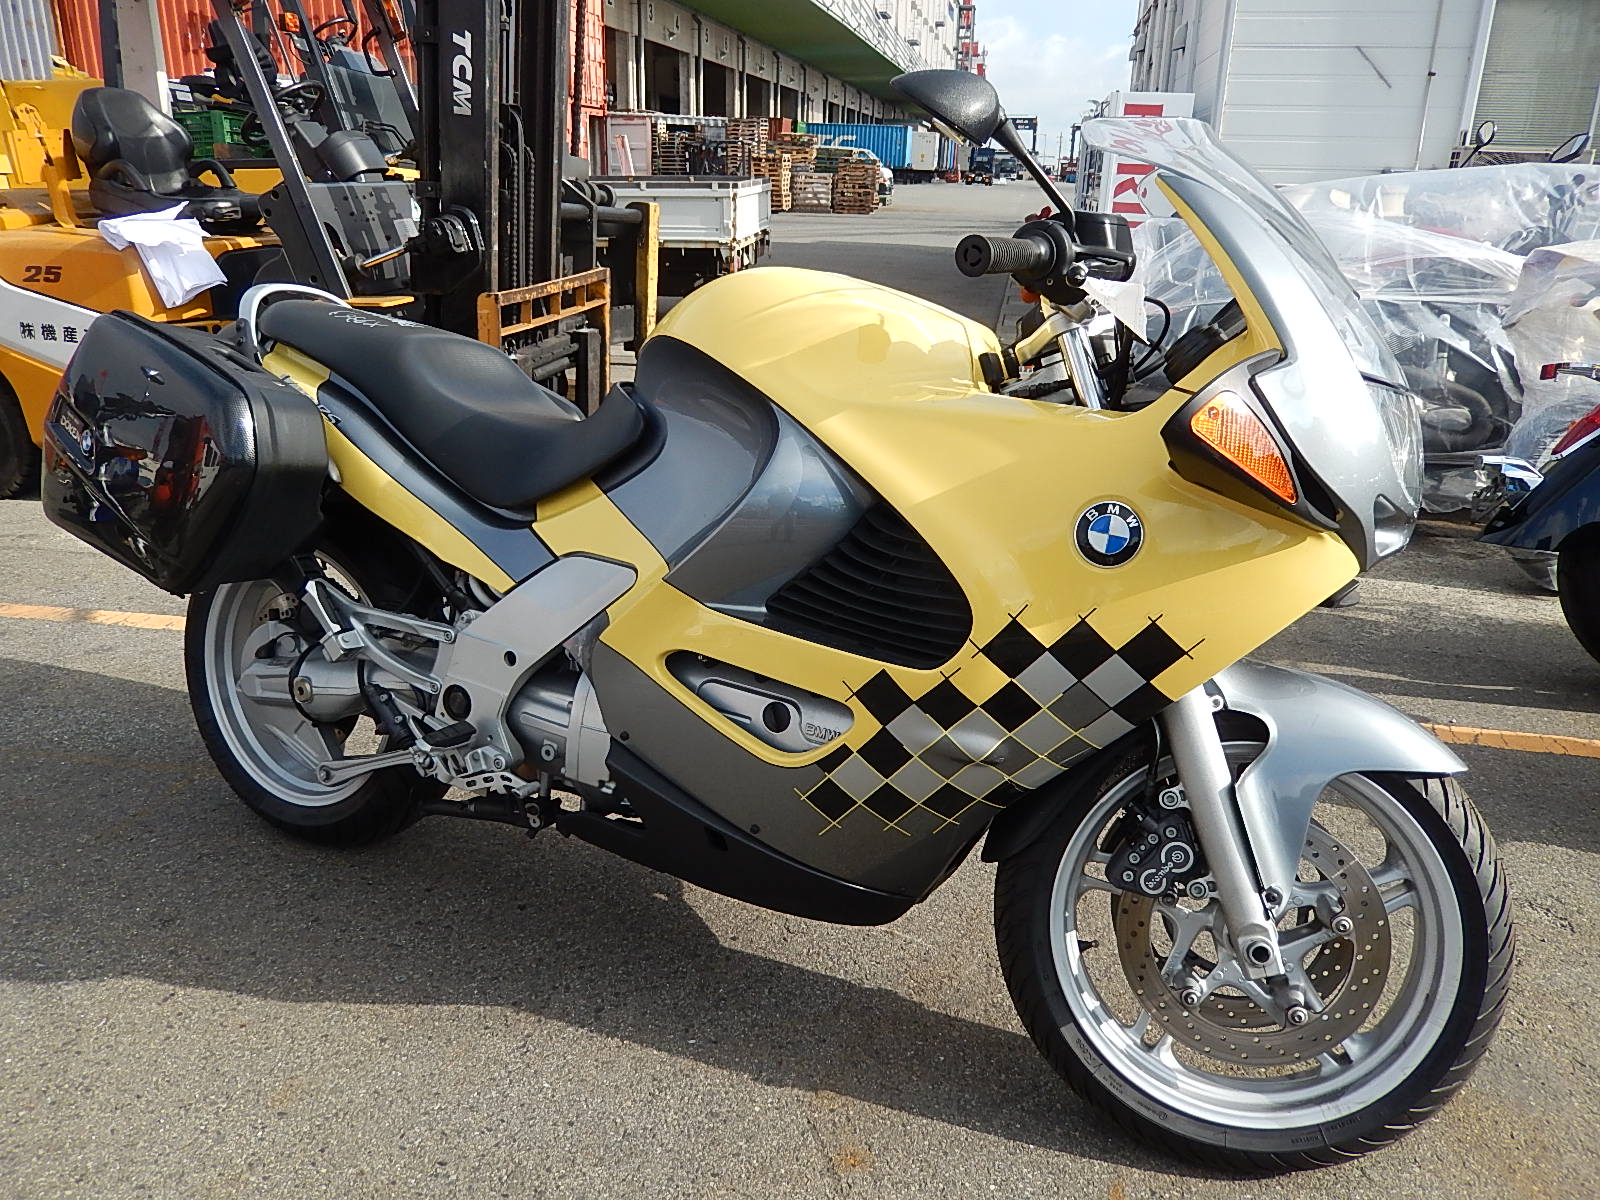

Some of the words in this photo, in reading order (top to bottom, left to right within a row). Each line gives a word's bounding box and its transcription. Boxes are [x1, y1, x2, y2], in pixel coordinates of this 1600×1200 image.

[453, 29, 472, 116] TCM
[22, 265, 63, 283] 25
[1085, 503, 1140, 528] BMW
[805, 722, 841, 742] BMW
